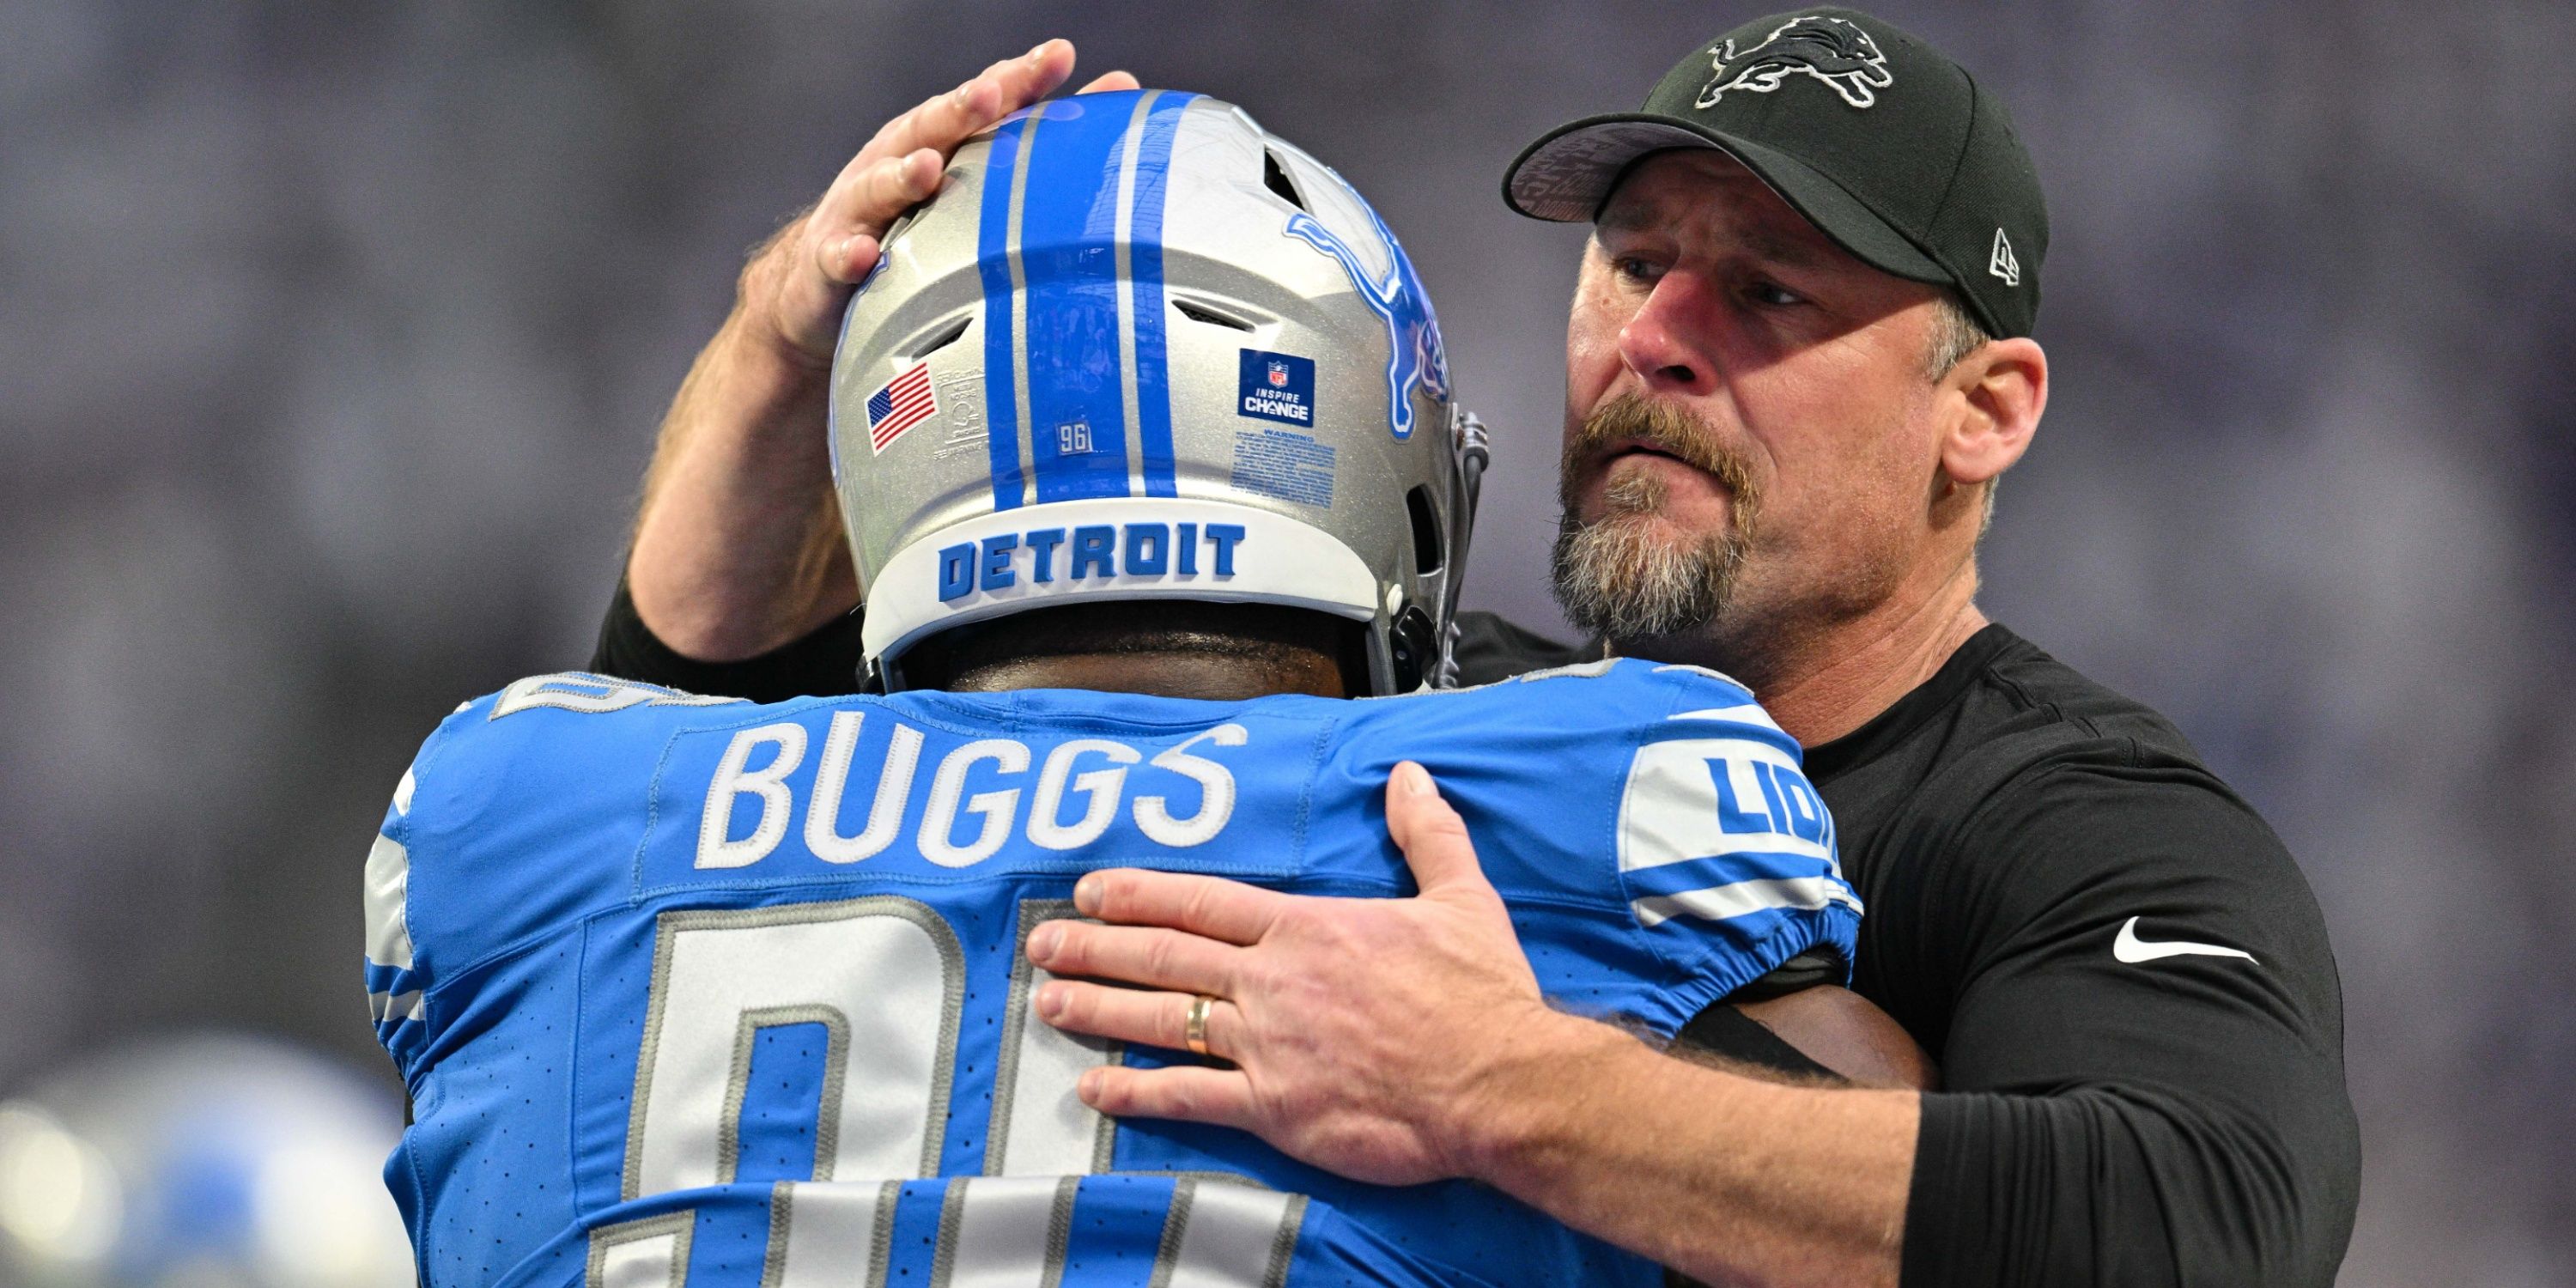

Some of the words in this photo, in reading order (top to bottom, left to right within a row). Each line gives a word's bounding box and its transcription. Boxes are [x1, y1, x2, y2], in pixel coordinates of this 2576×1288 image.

[1255, 388, 1300, 403] INSPIRE
[1244, 397, 1309, 421] CHANGE
[1060, 423, 1086, 452] 96
[1263, 429, 1315, 443] WARNING
[938, 521, 1246, 602] DETROIT
[694, 710, 1249, 871] BUGGS
